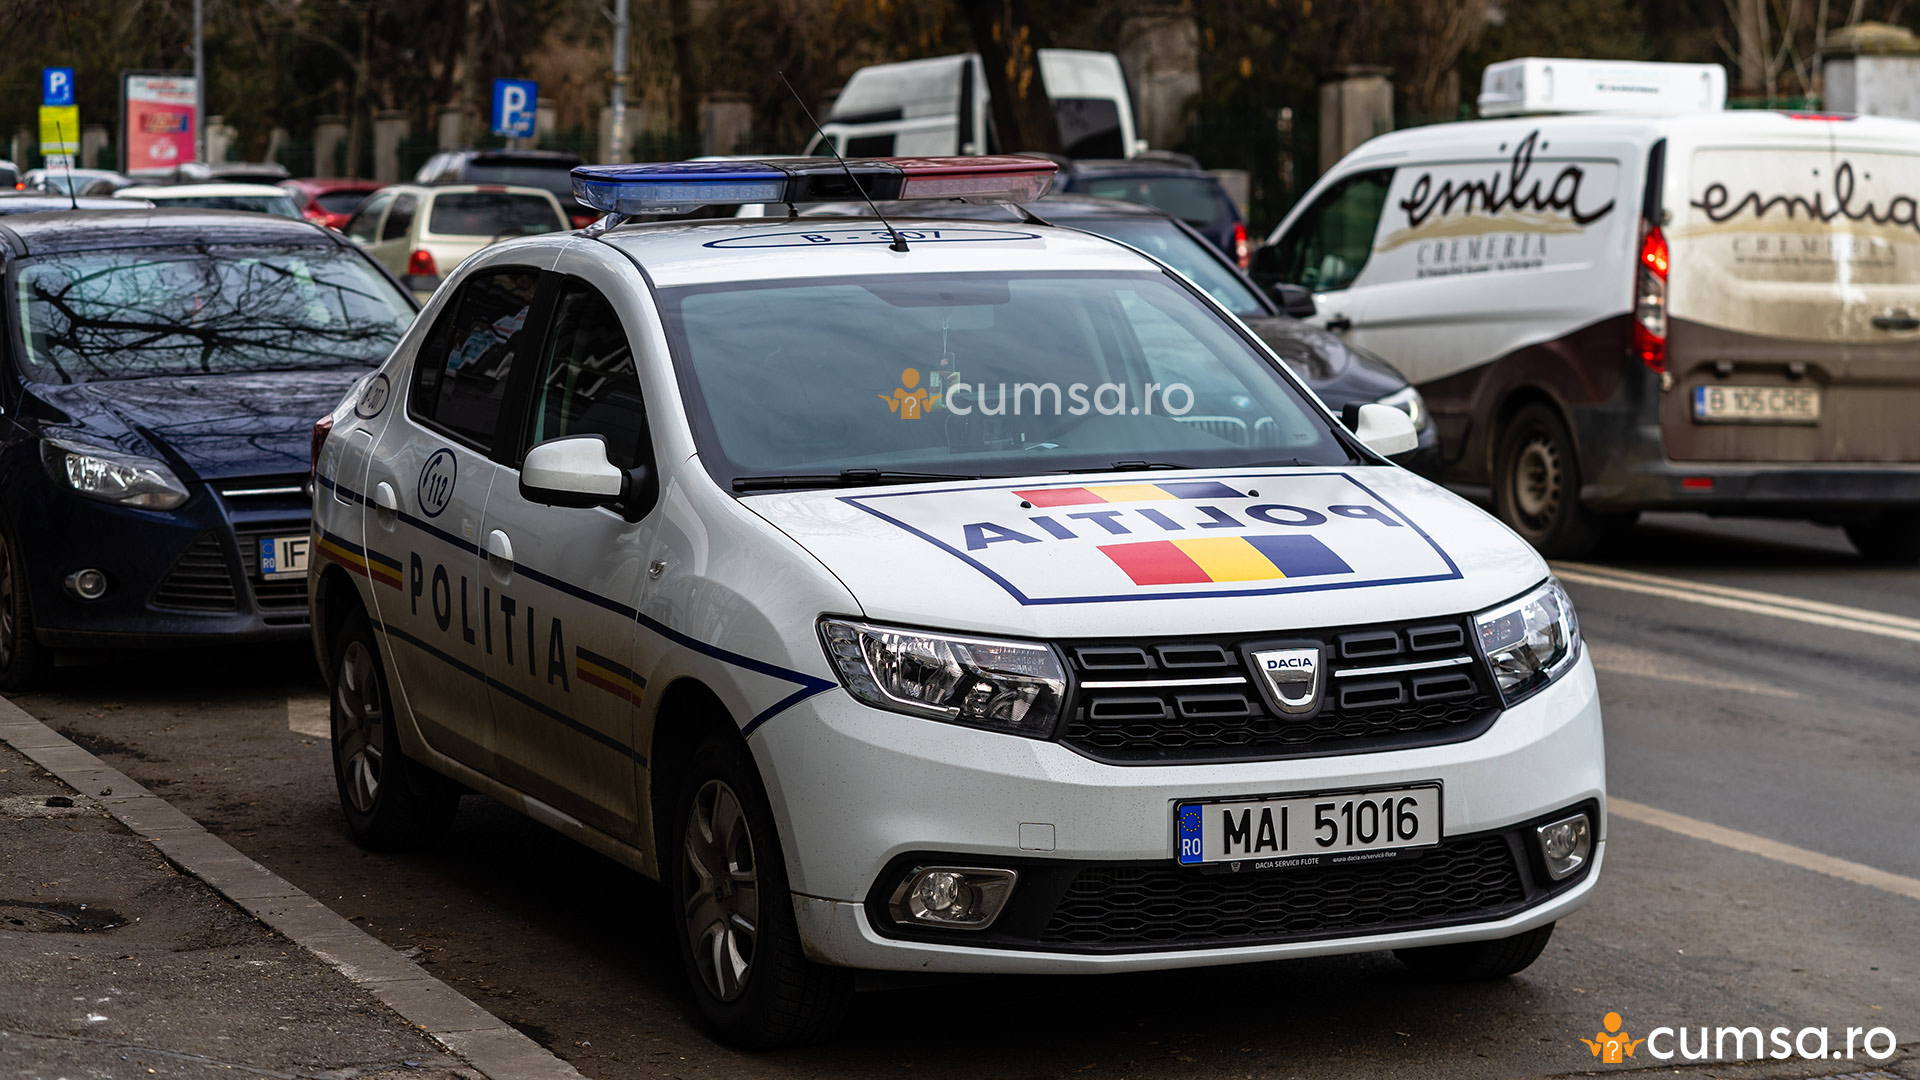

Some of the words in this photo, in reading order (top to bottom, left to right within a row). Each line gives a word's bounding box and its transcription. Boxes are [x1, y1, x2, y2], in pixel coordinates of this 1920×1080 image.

[50, 72, 66, 94] P
[501, 86, 528, 130] P
[1400, 128, 1616, 228] emilia
[1690, 160, 1920, 232] emilia
[801, 234, 831, 244] B
[871, 231, 941, 240] 307
[1417, 233, 1547, 265] CREMERIA
[1710, 390, 1725, 411] B
[427, 471, 448, 507] 112
[263, 557, 275, 569] RO
[283, 540, 308, 567] IF
[410, 551, 570, 692] POLITIA
[1267, 658, 1312, 669] DACIA
[1223, 805, 1289, 855] MAI
[1314, 795, 1419, 848] 51016
[1182, 837, 1201, 856] RO
[1255, 861, 1273, 869] DACIA
[1274, 859, 1299, 869] SERVICII
[1300, 857, 1319, 867] FLOTE
